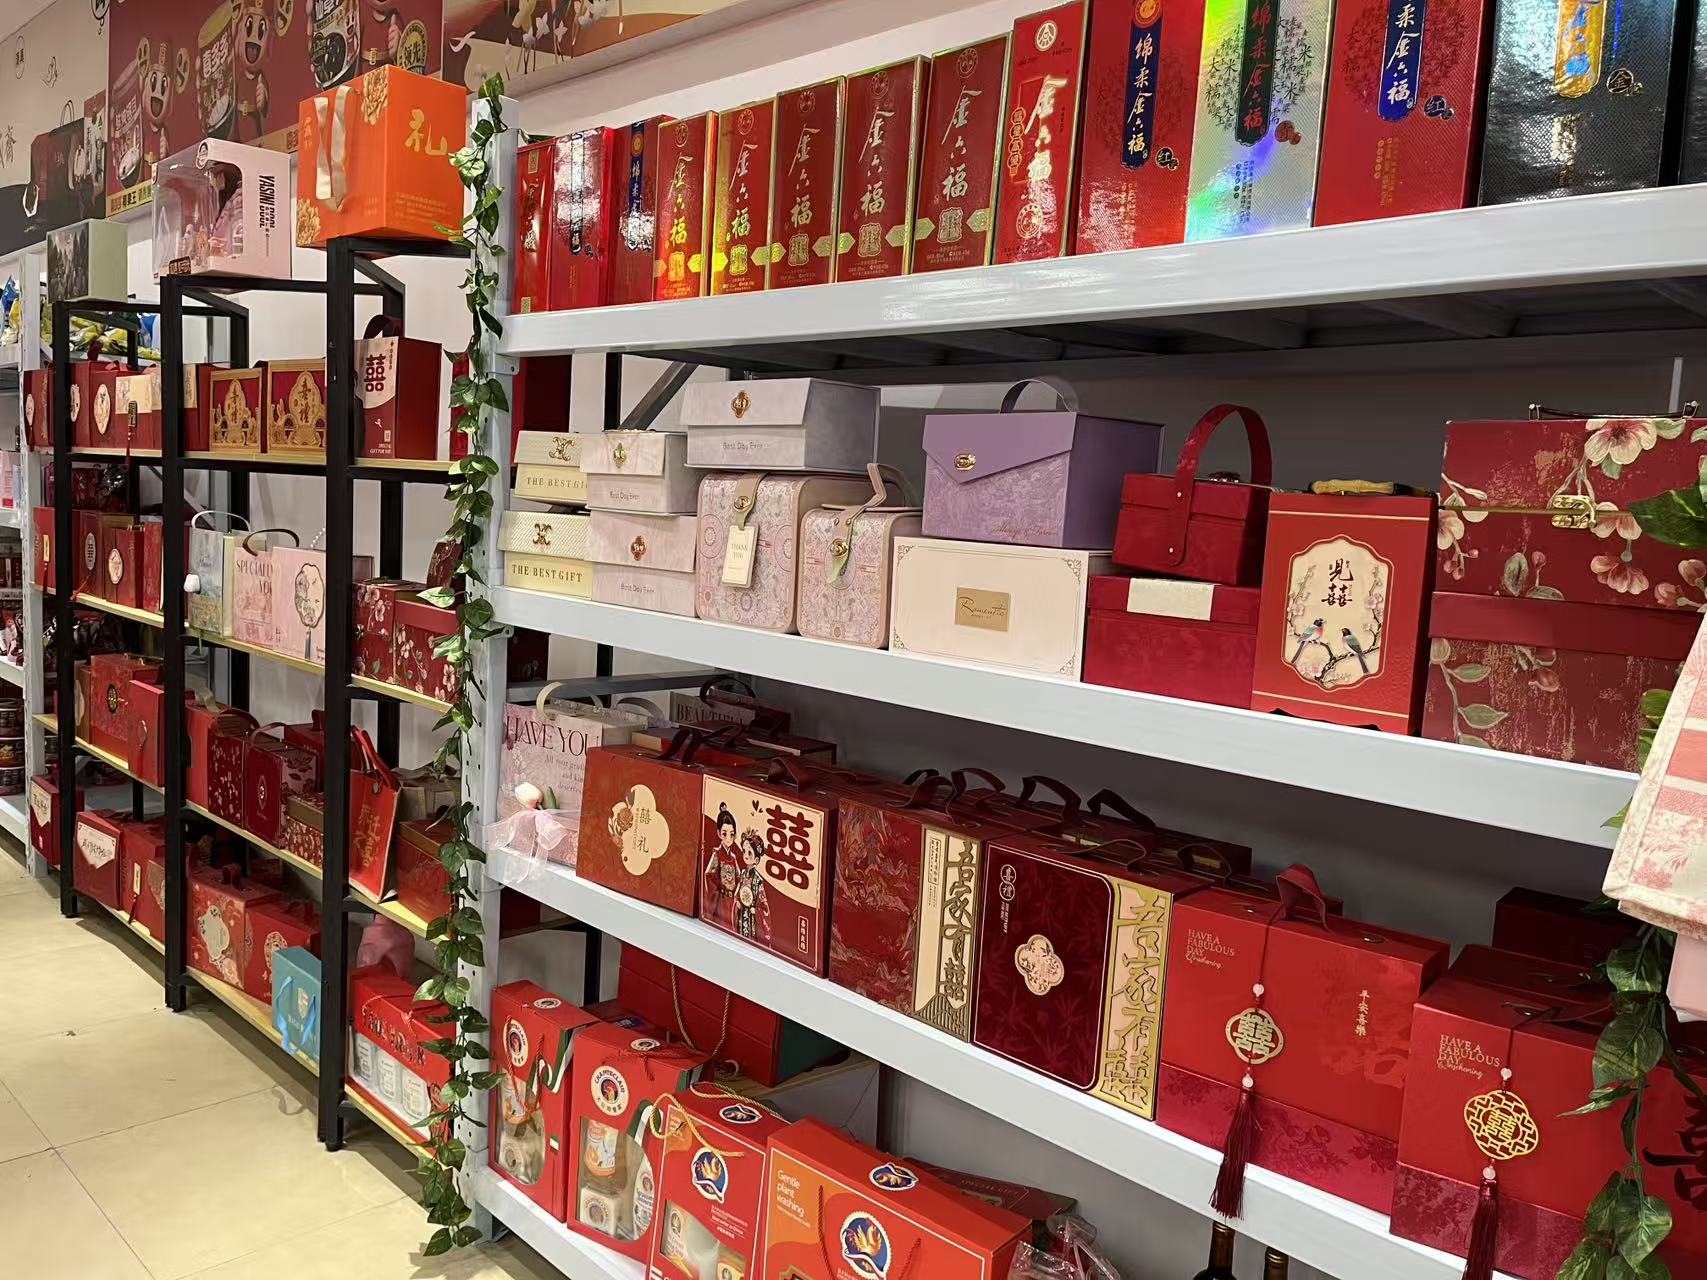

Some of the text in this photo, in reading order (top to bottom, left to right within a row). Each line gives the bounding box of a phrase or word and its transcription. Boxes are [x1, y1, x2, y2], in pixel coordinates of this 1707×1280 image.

[1610, 71, 1631, 89] 金
[1127, 33, 1153, 156] 绵柔金六福
[405, 109, 448, 156] 礼
[941, 85, 982, 202] 金六福
[858, 107, 895, 217] 金六福
[788, 124, 820, 228] 金六福
[259, 175, 275, 206] YASINI
[667, 152, 693, 246] 金六福
[729, 140, 758, 239] 金六福
[526, 477, 544, 486] THE
[547, 478, 572, 488] BEST
[512, 564, 583, 582] THE BEST GIFT
[766, 804, 814, 890] 囍
[1187, 938, 1235, 956] FABULOUS
[1188, 928, 1220, 944] HAVE A
[1187, 945, 1205, 956] DAY
[1440, 1034, 1482, 1053] HAVE A
[1438, 1052, 1460, 1064] DAY
[1439, 1044, 1501, 1067] FABULOUS
[777, 1183, 795, 1198] plant
[778, 1170, 800, 1189] Gentle
[776, 1194, 805, 1217] washing
